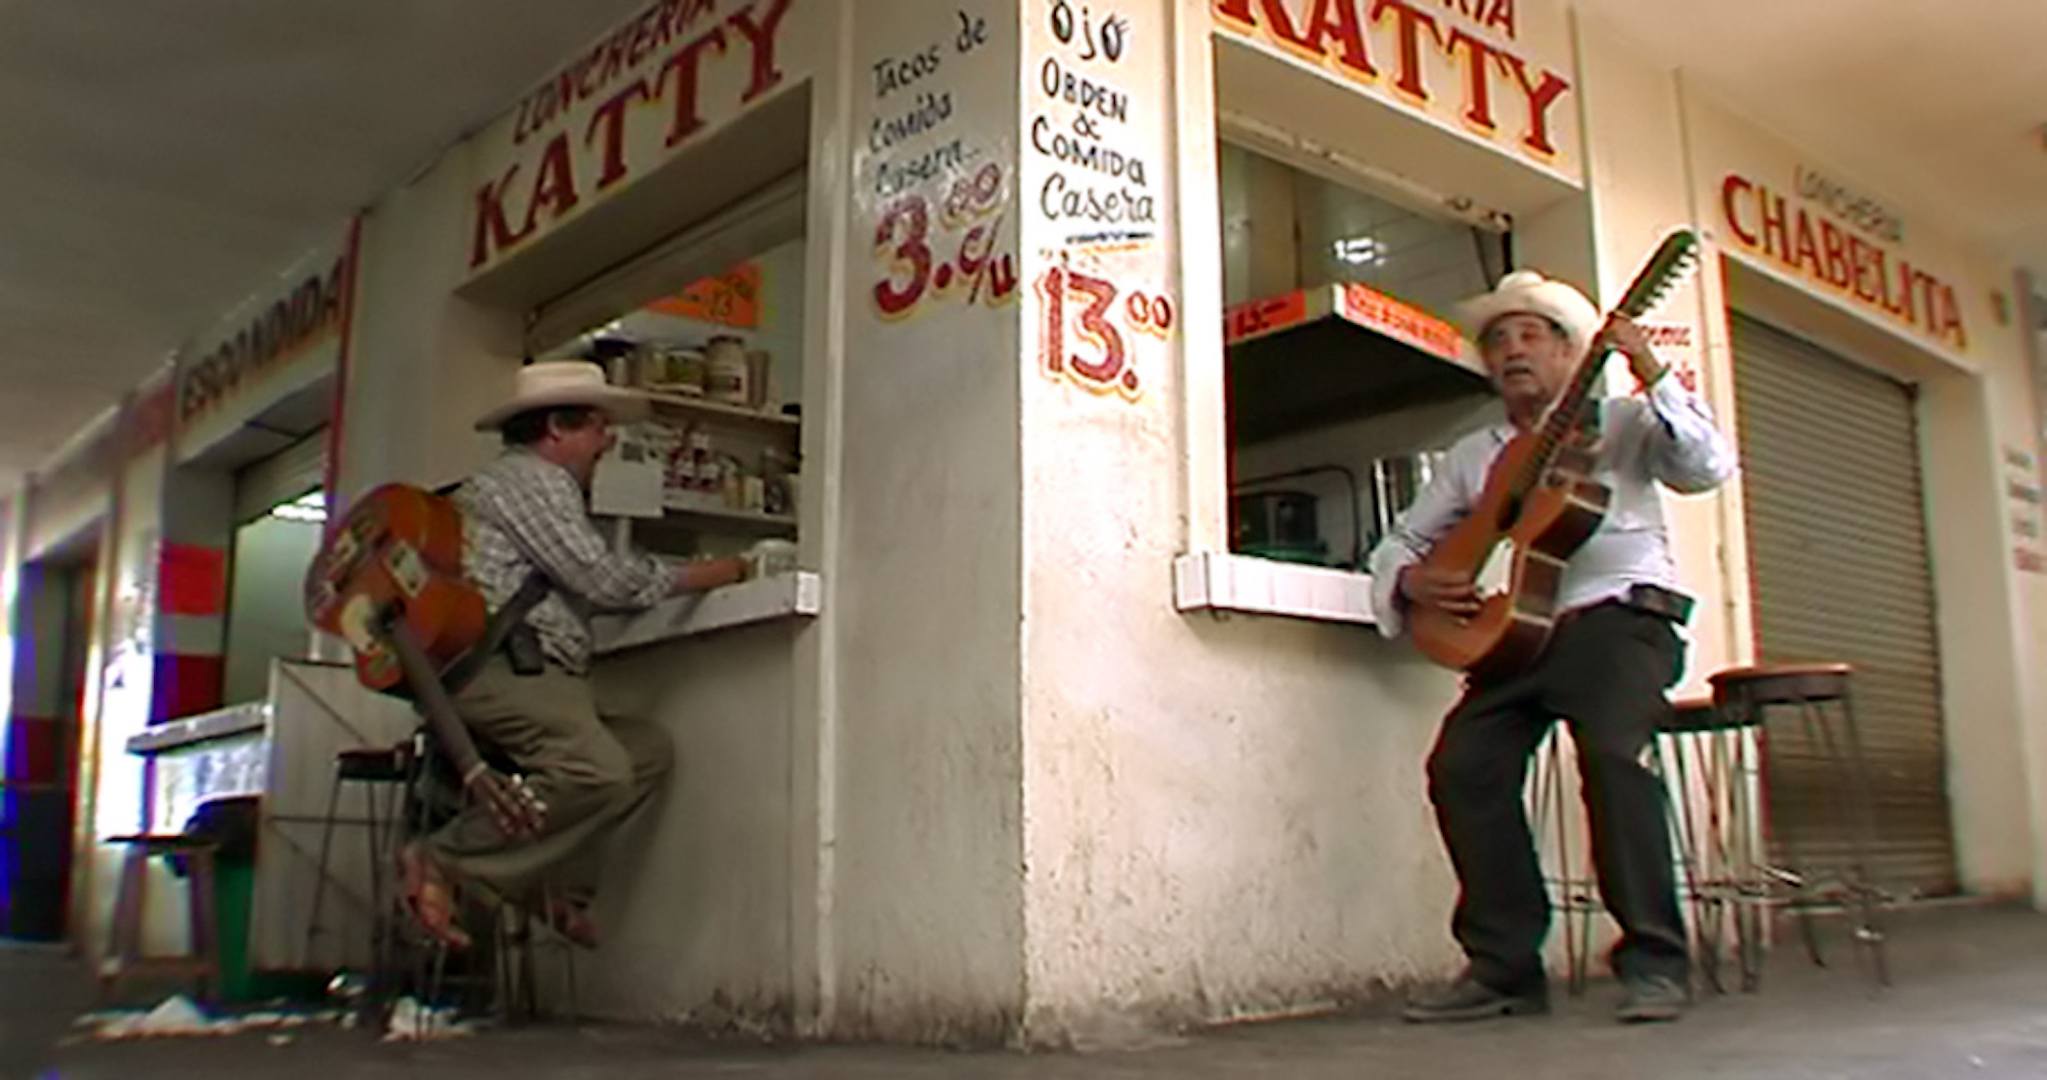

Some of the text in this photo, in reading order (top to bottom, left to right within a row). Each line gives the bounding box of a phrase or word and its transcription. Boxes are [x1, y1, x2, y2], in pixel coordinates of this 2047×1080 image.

[873, 10, 989, 97] Tacos de
[470, 0, 791, 268] KATTY
[869, 92, 952, 152] Comida
[1040, 173, 1156, 223] Casera
[1722, 174, 1967, 348] CHABELITA
